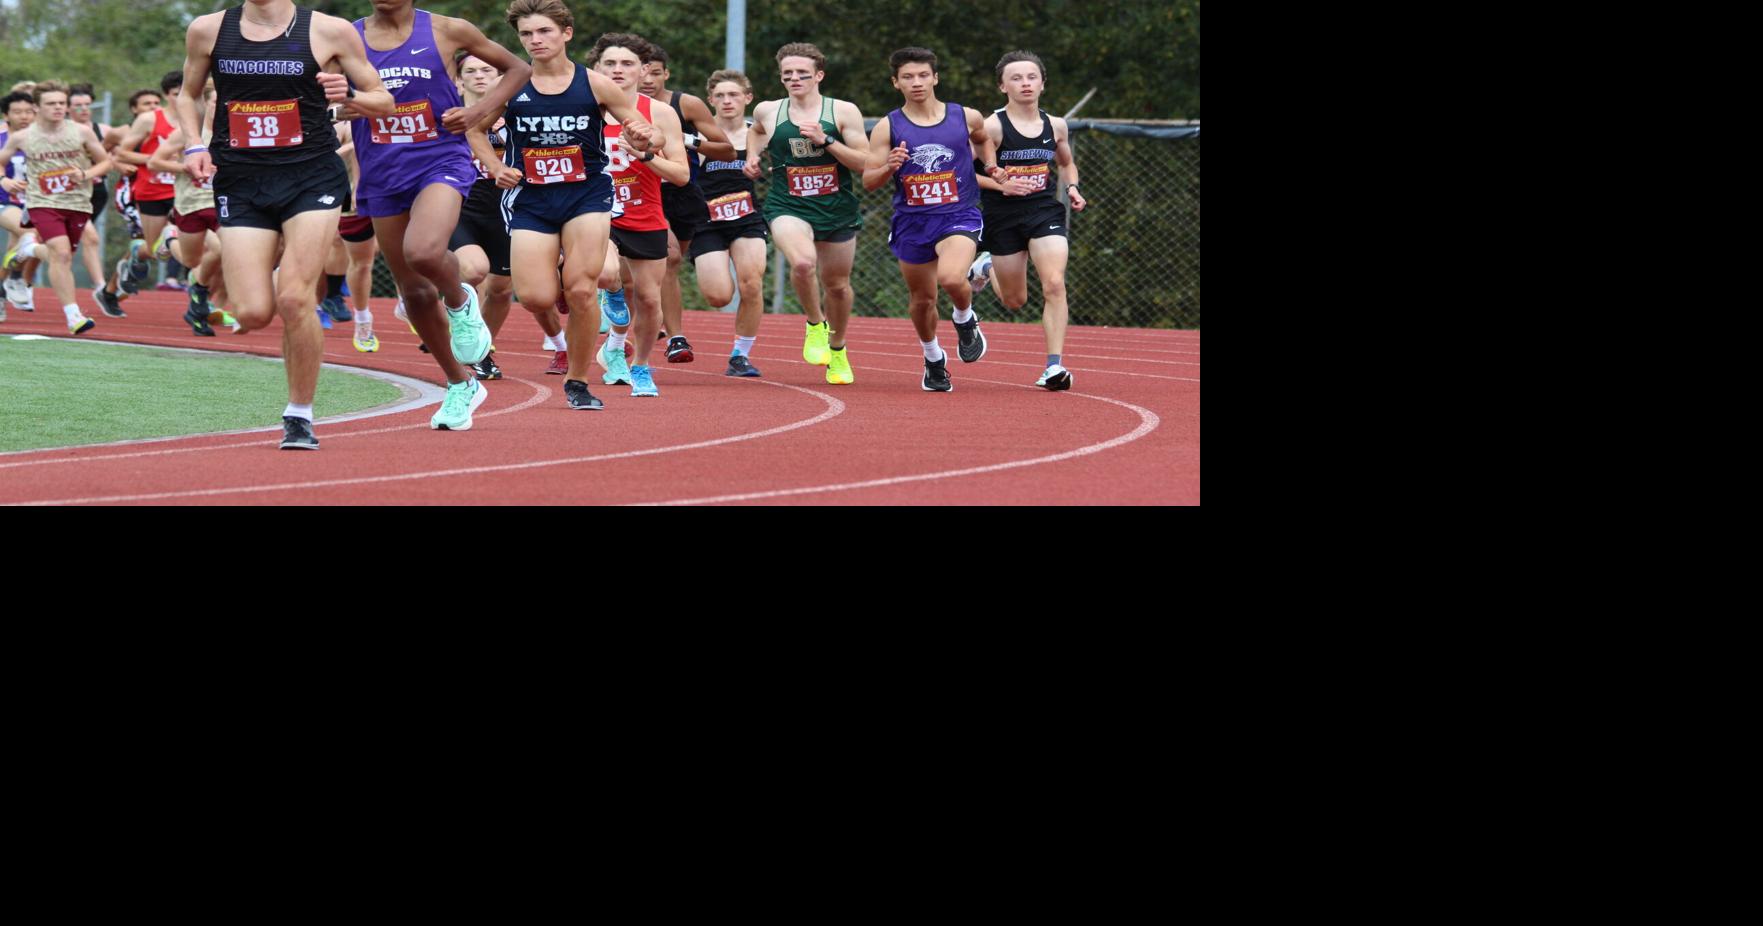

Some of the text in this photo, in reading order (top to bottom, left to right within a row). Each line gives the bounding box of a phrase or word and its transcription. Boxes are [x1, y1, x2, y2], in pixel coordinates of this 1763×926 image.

[218, 59, 304, 75] ANACORTES
[379, 66, 432, 79] DCATS
[247, 115, 280, 138] 38
[375, 113, 429, 134] 1291
[515, 115, 590, 132] LYNCS
[1000, 148, 1057, 161] SHOREWO
[535, 157, 574, 176] 920
[792, 174, 835, 190] 1852
[910, 181, 953, 199] 1241
[619, 185, 632, 202] 9
[714, 199, 750, 218] 1674
